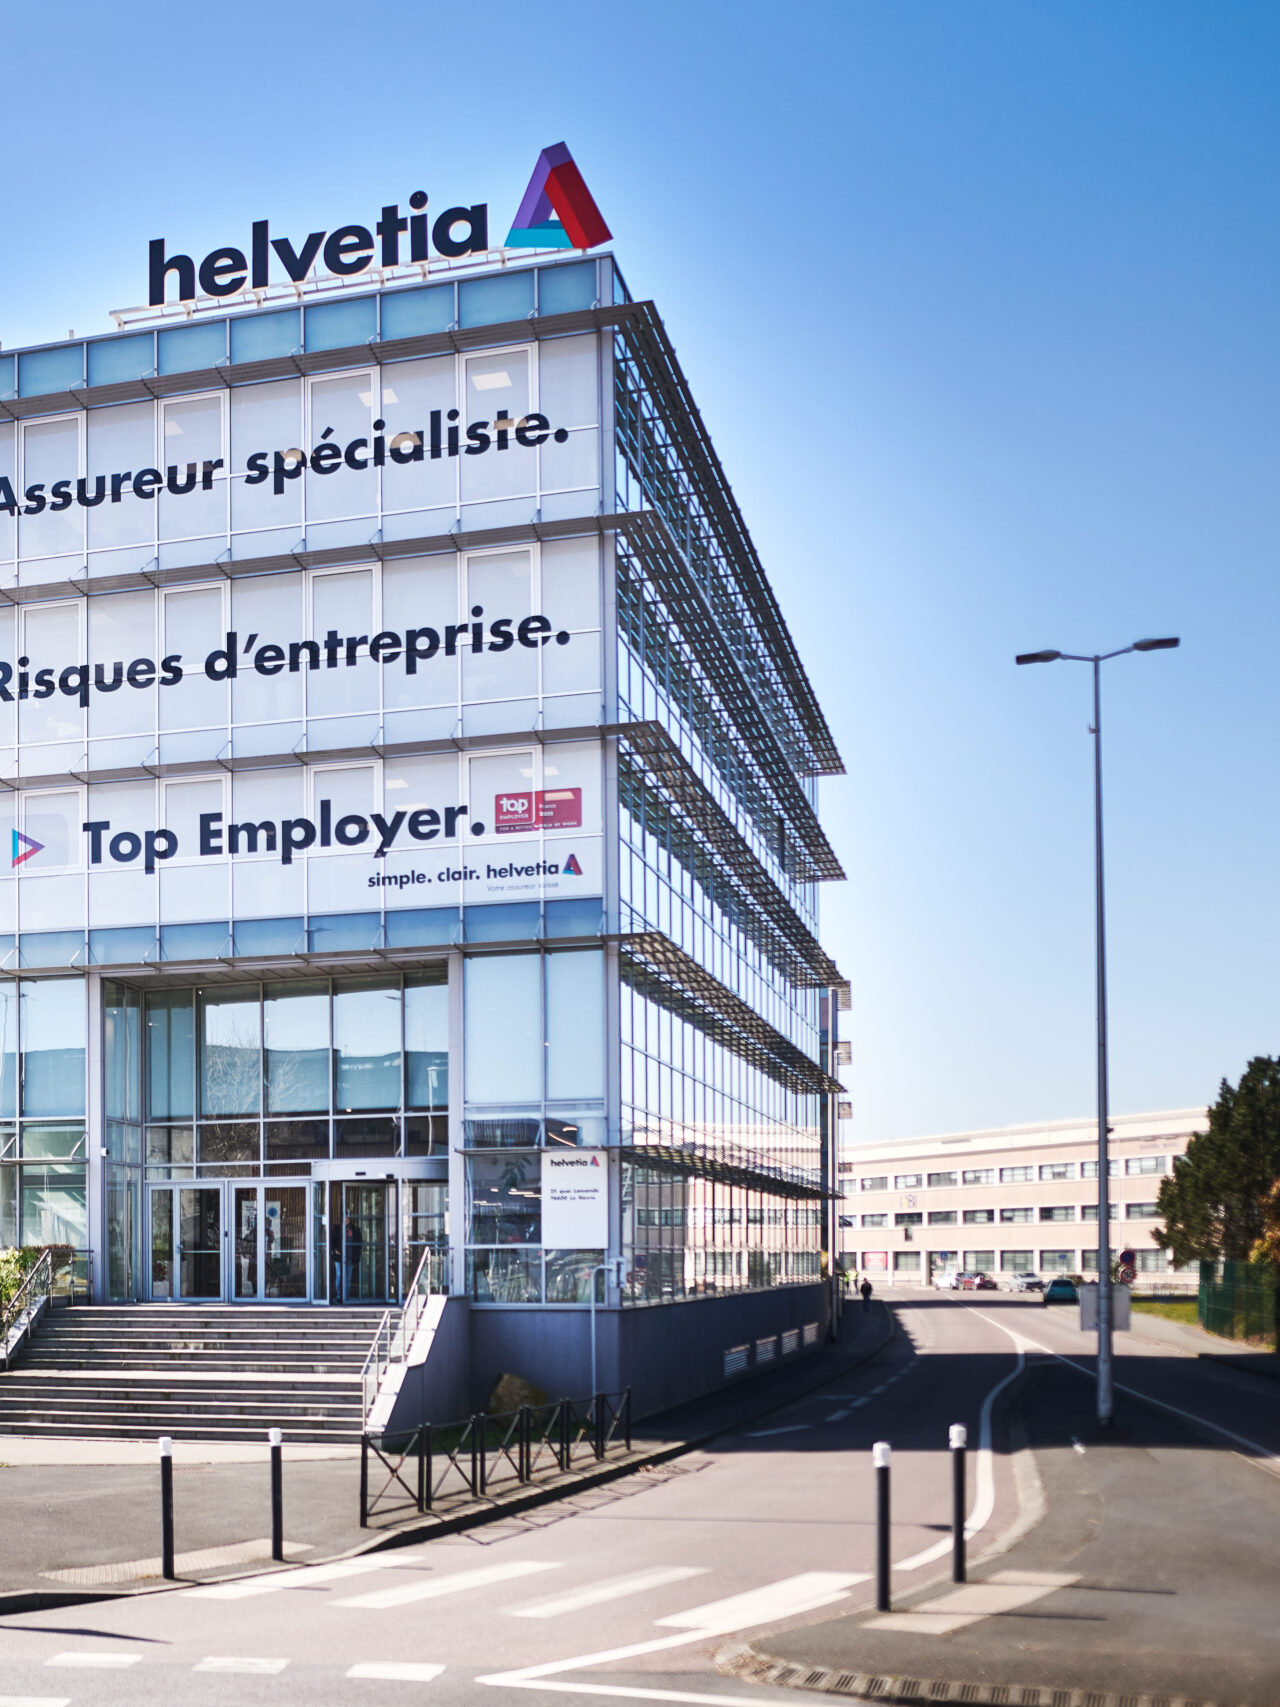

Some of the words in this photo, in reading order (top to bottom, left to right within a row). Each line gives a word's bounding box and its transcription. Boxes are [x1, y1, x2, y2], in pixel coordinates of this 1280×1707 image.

[149, 190, 489, 307] helvetia
[244, 408, 569, 495] spécialiste.
[204, 605, 571, 676] d'entreprise.
[499, 797, 529, 813] top
[83, 819, 178, 875] Top
[199, 799, 486, 865] Employer.
[367, 869, 432, 890] simple.
[437, 866, 481, 882] clair.
[486, 860, 559, 879] helvetia
[486, 884, 506, 893] Votre
[507, 882, 536, 891] assureur
[550, 1159, 588, 1167] helvetia
